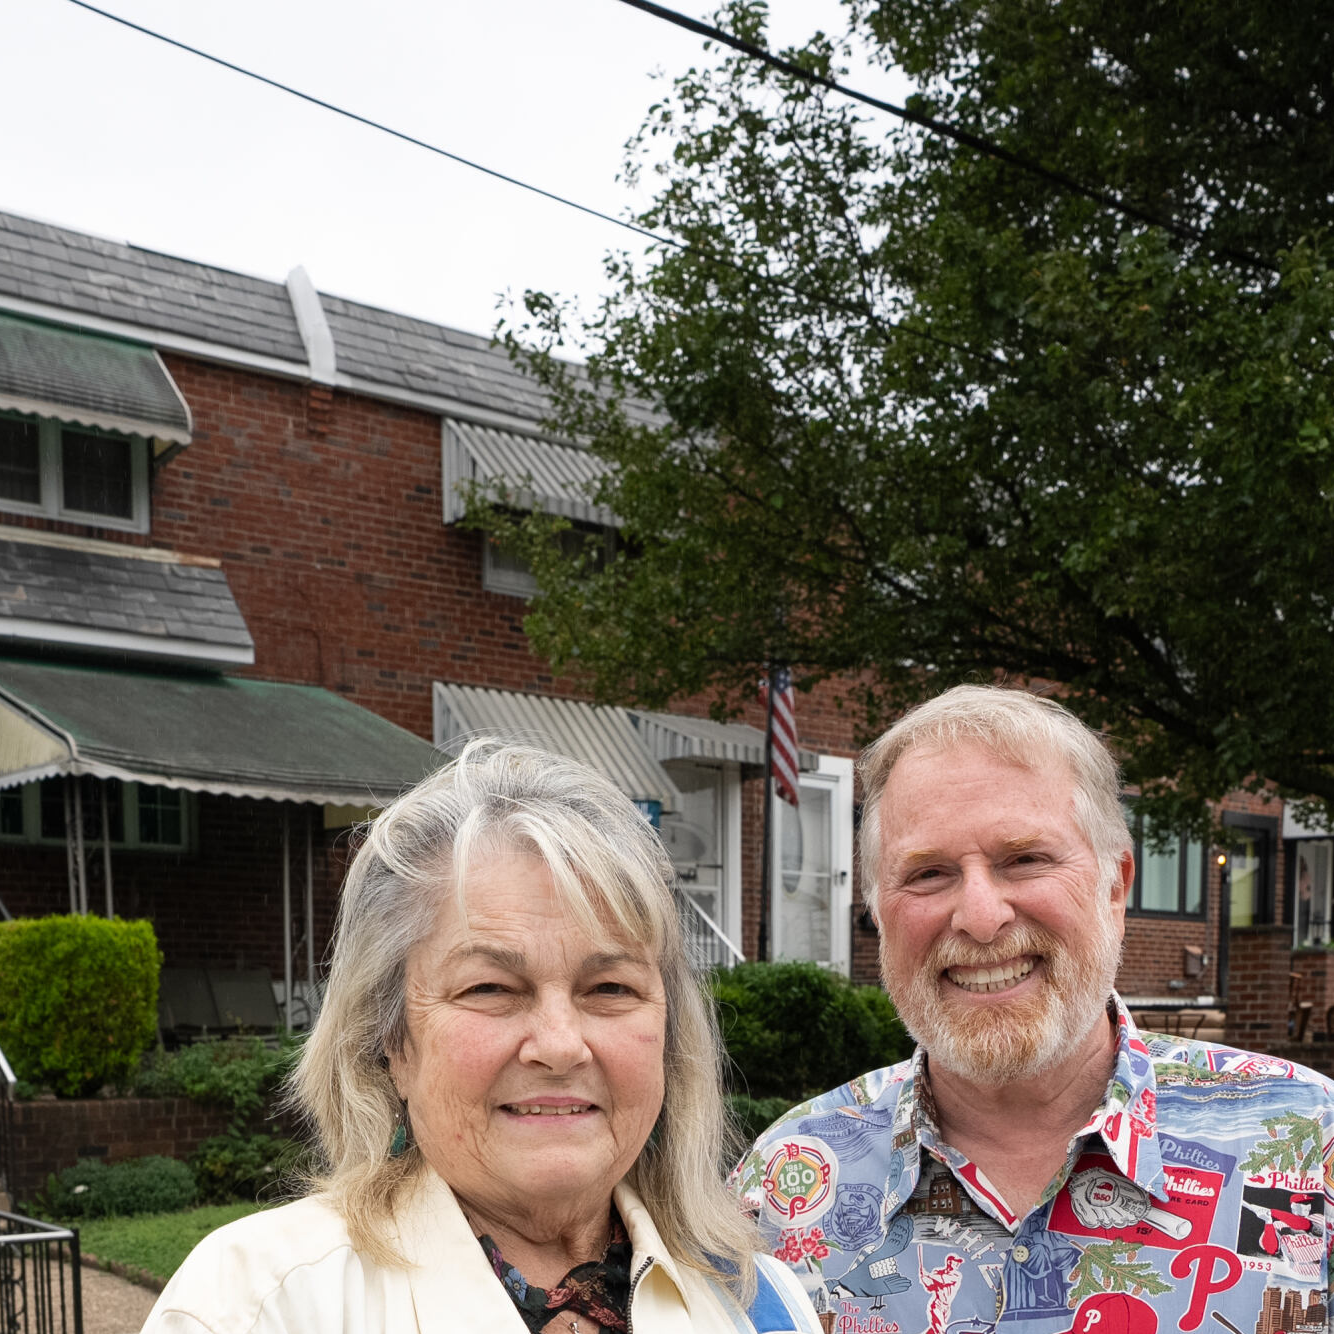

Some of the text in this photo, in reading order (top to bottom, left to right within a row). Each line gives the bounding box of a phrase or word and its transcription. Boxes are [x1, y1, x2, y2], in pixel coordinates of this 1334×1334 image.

[1160, 1139, 1221, 1171] Phillies
[779, 1168, 816, 1191] 100
[1165, 1175, 1216, 1198] hillies
[1185, 1198, 1210, 1207] CARD
[1242, 1260, 1273, 1272] 1953
[1170, 1243, 1244, 1332] P
[840, 1302, 860, 1315] The
[1083, 1309, 1102, 1333] P
